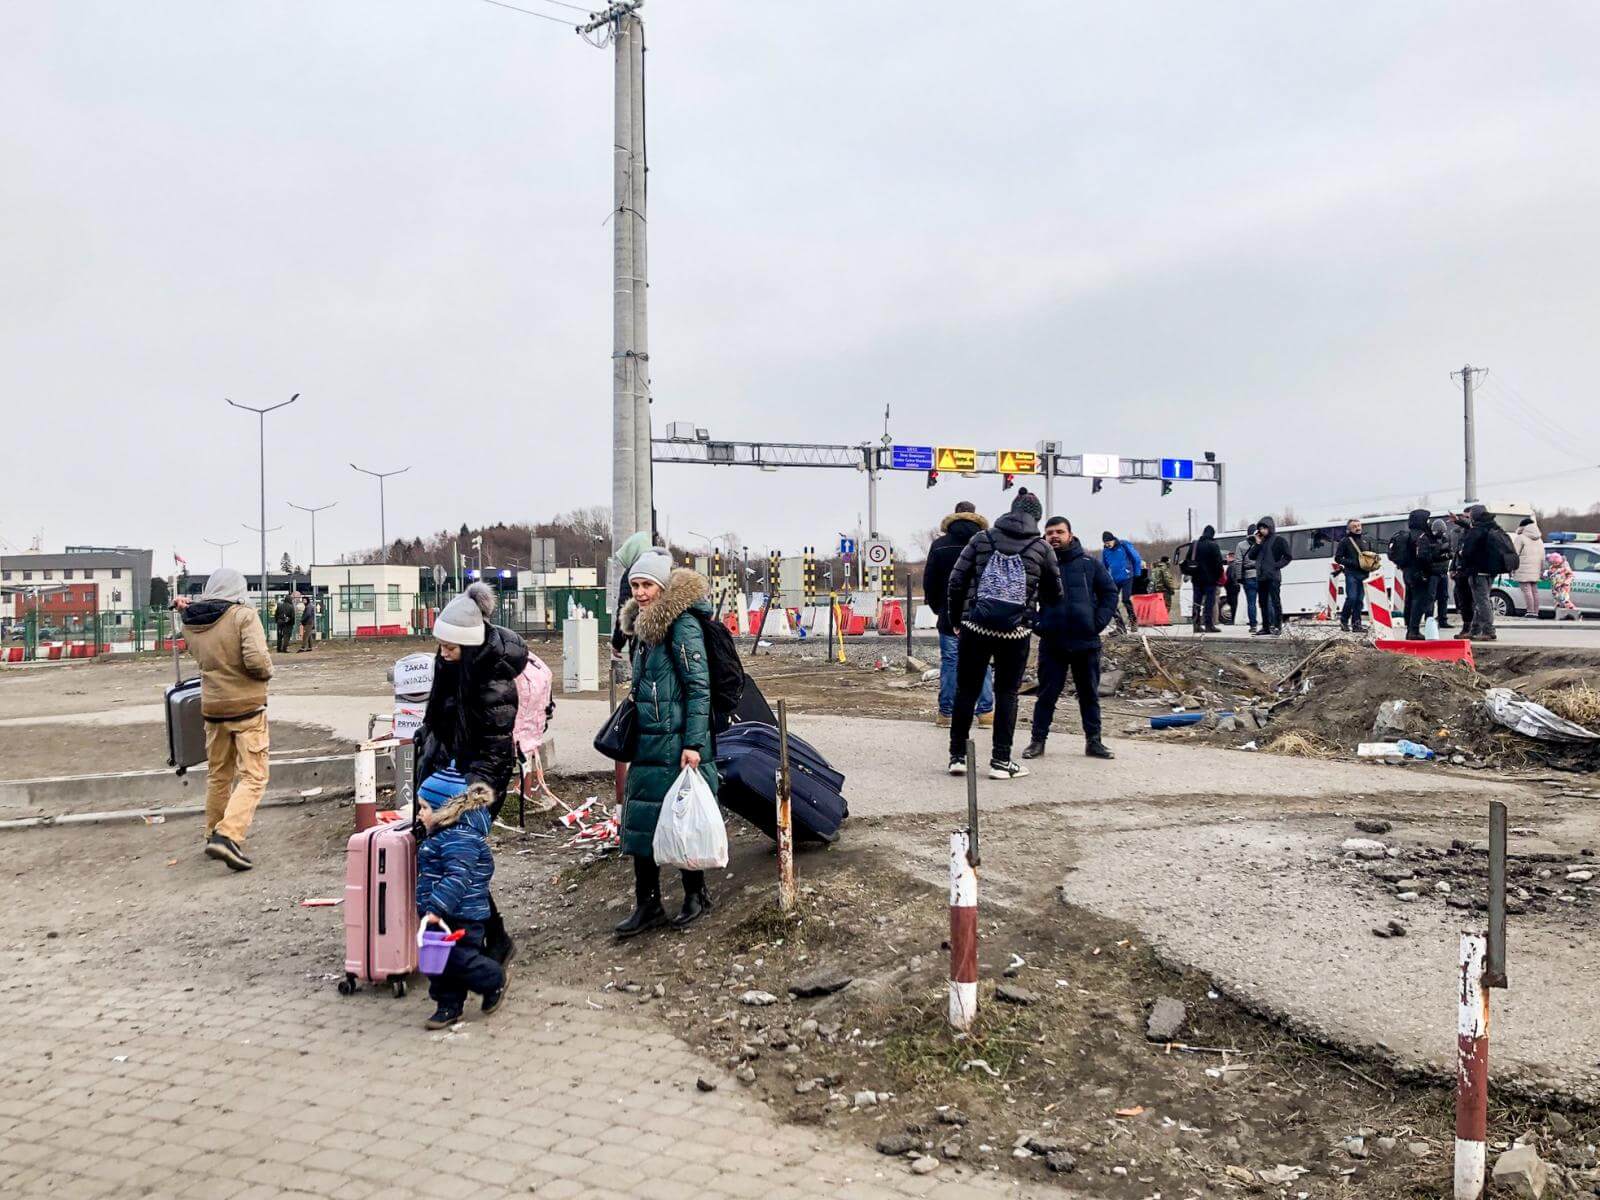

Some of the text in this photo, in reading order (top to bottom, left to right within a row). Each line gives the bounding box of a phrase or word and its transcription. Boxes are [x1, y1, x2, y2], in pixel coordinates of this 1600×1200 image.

[875, 550, 881, 559] 5
[405, 663, 429, 672] ZAKAZ
[397, 720, 422, 728] PRYWA
